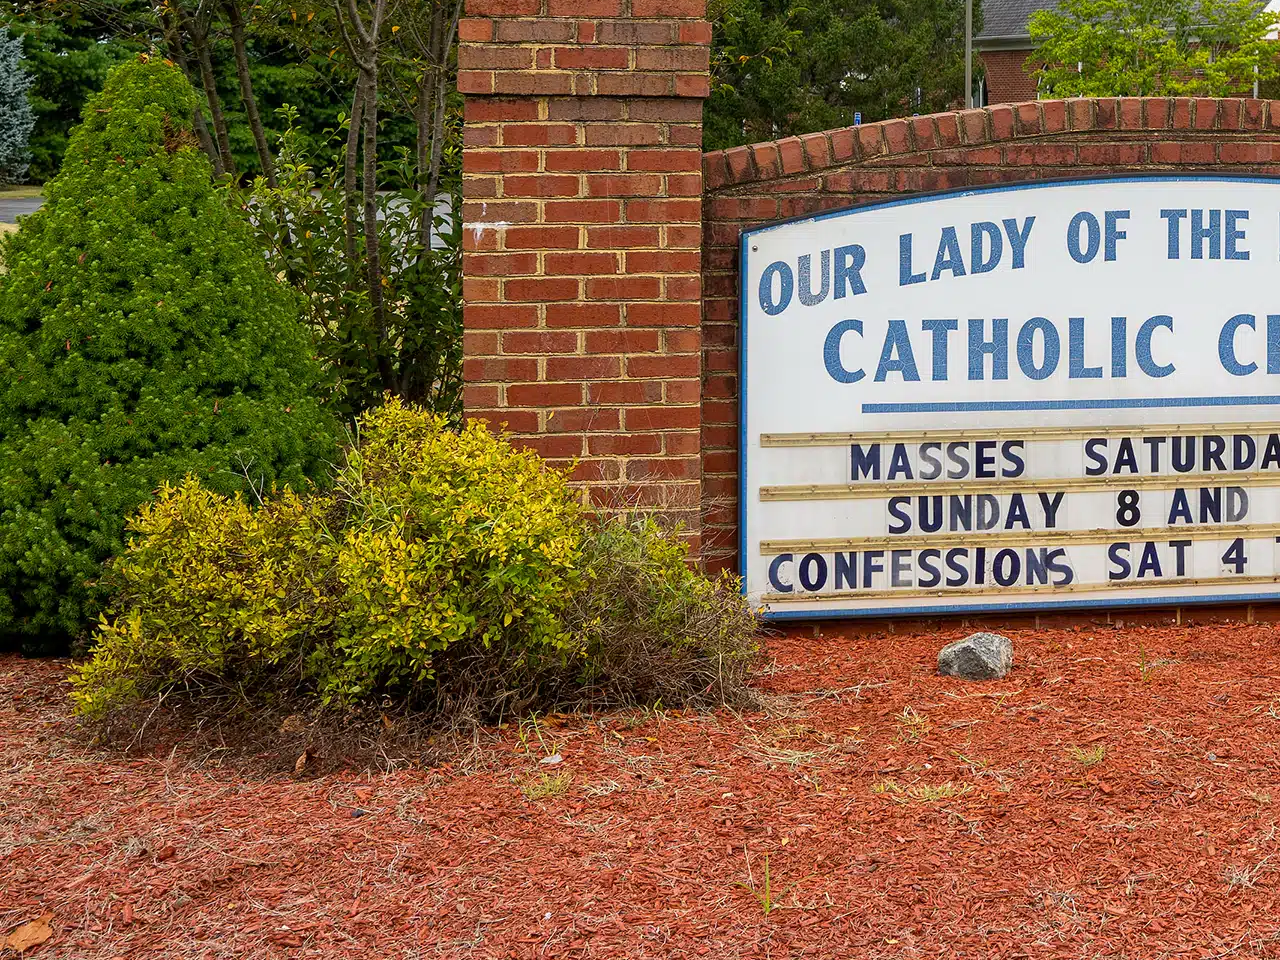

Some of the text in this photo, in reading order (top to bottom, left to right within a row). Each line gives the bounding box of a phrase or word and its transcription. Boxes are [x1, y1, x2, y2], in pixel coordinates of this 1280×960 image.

[758, 243, 868, 316] OUR
[898, 215, 1036, 286] LADY
[1067, 209, 1131, 264] OF
[1161, 208, 1250, 260] THE
[823, 315, 1175, 384] CATHOLIC
[850, 440, 1026, 481] MASSES
[888, 491, 1065, 534] SUNDAY
[1116, 489, 1140, 526] 8
[1168, 485, 1249, 524] AND
[768, 547, 1075, 592] CONFESSIONS
[1108, 540, 1192, 580] SAT
[1222, 538, 1248, 575] 4
